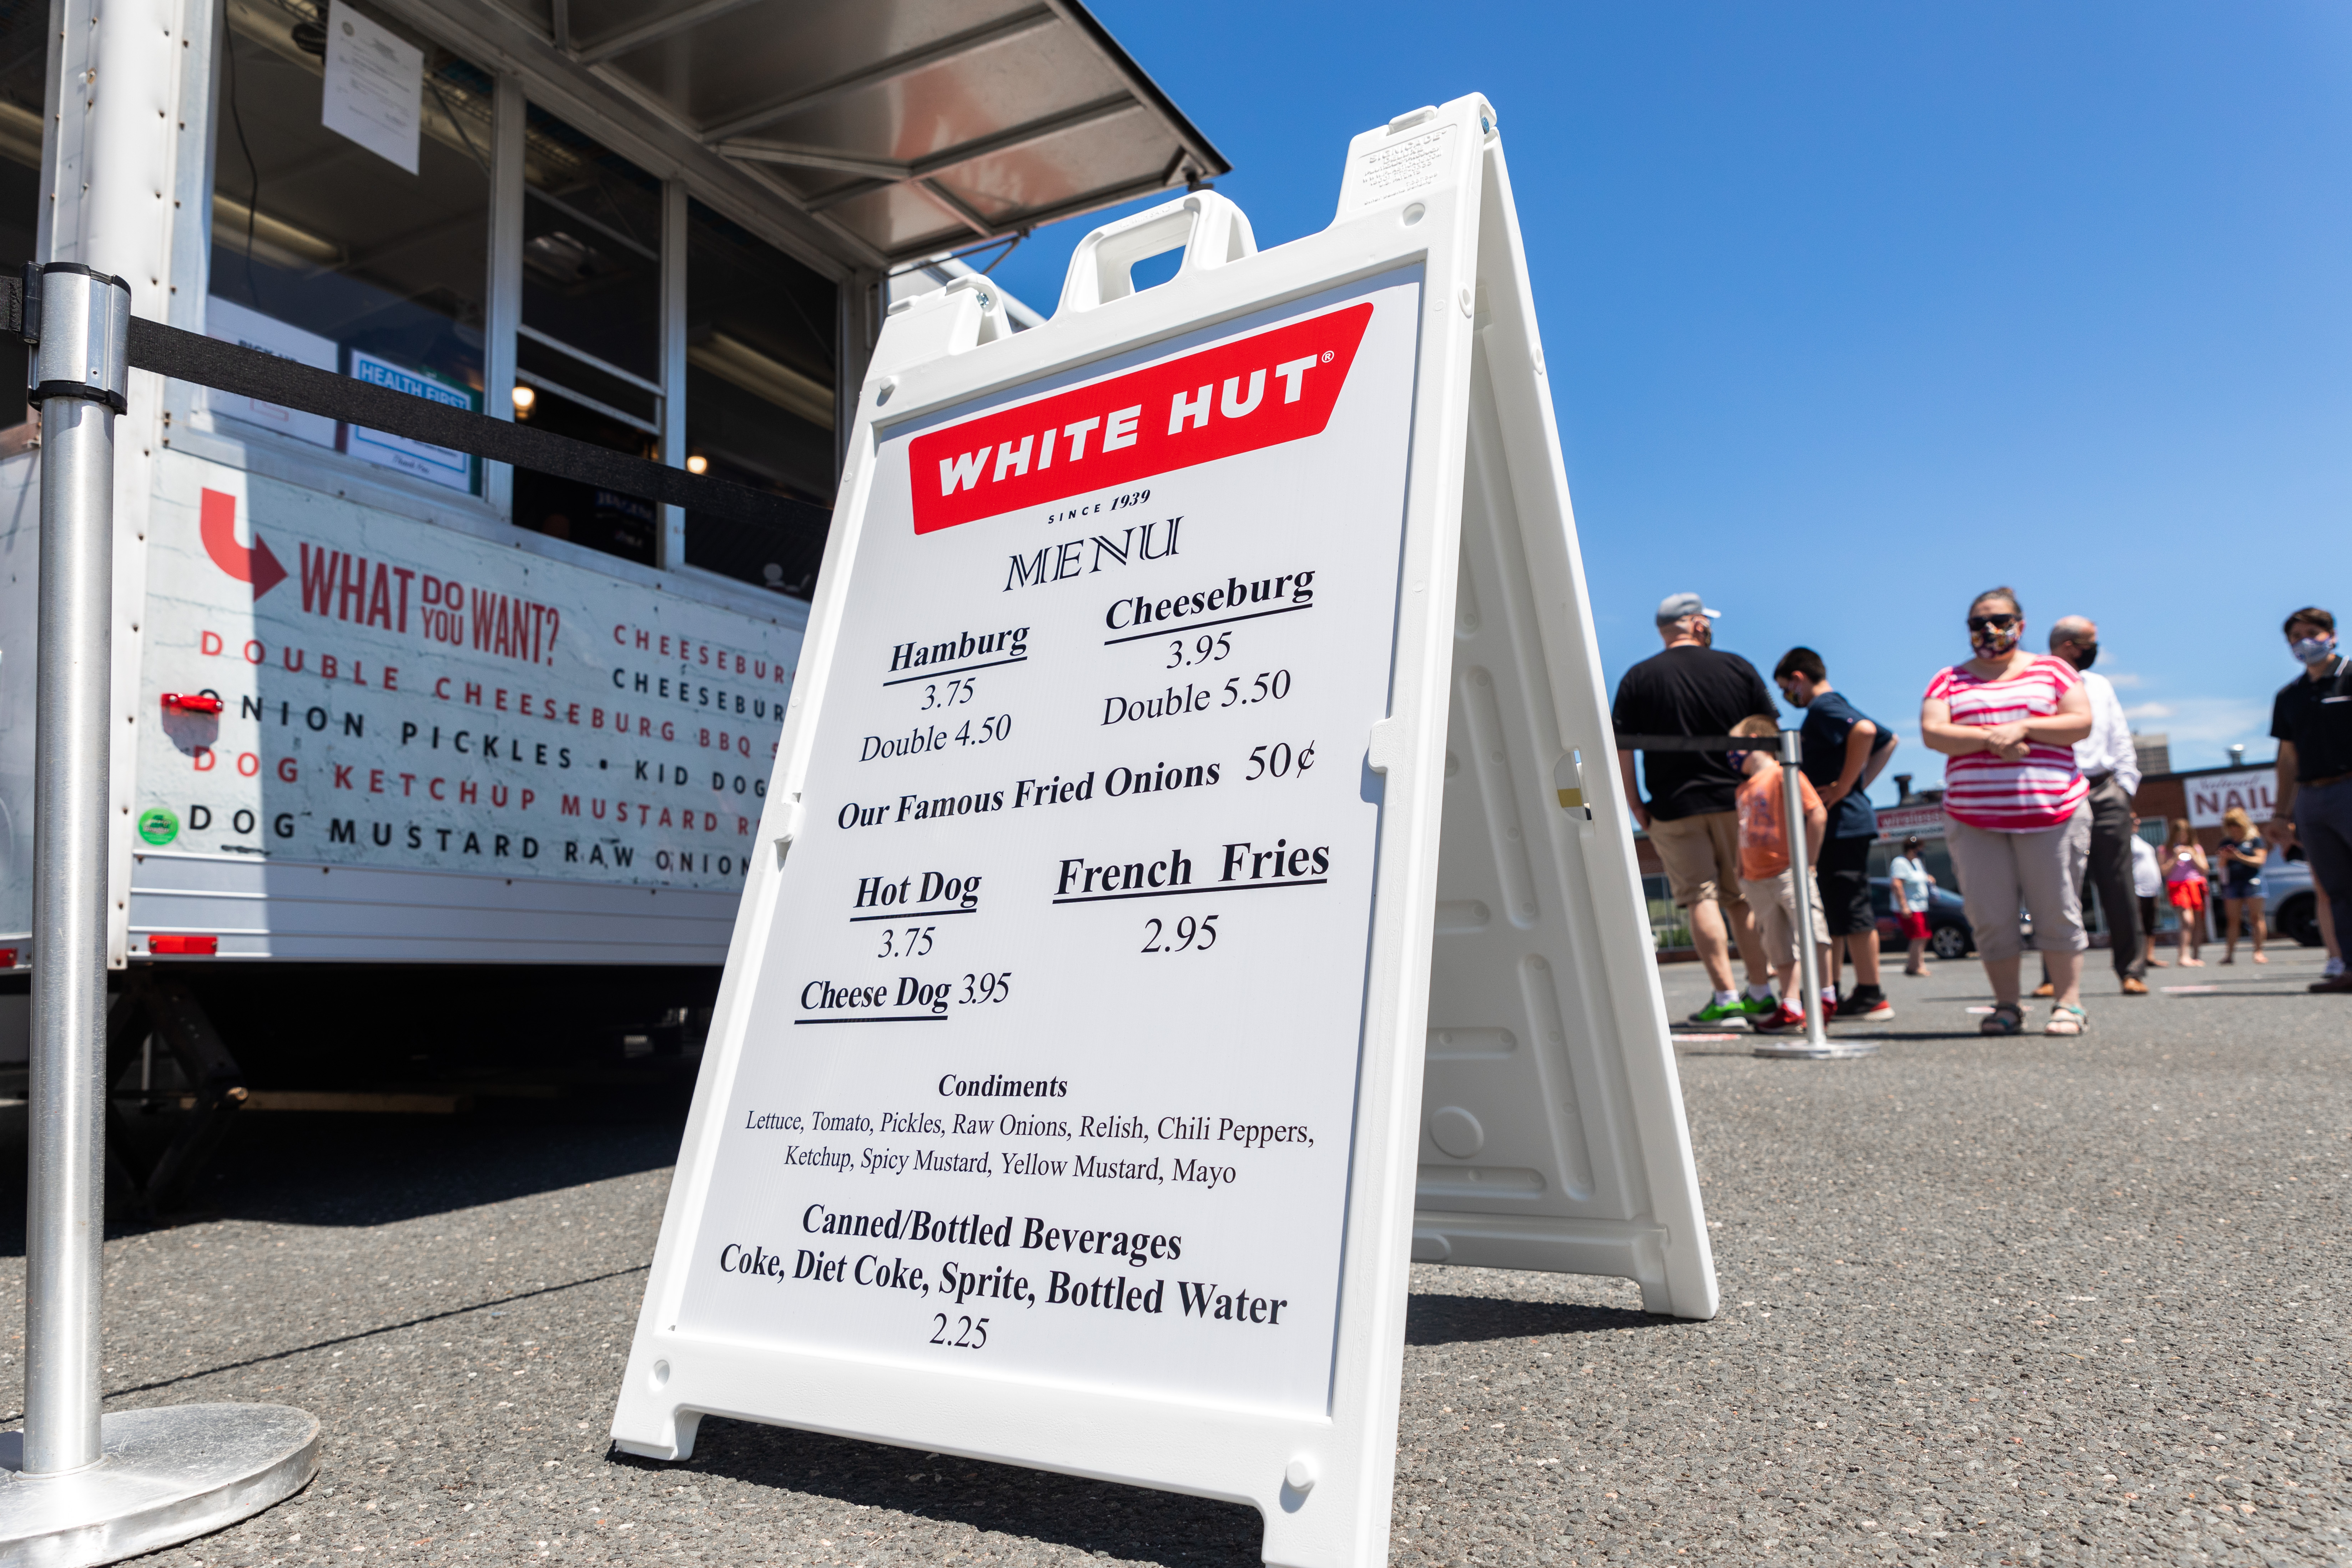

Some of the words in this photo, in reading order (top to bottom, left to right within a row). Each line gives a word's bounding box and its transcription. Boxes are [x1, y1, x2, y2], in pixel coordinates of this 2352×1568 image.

[940, 404, 1142, 496] WHITE
[1048, 504, 1100, 524] SINCE
[1110, 490, 1150, 511] 1939
[1003, 516, 1184, 592] MENU
[299, 541, 415, 634] WHAT
[422, 574, 464, 611] DO
[1106, 571, 1315, 629] Cheeseburg
[421, 605, 463, 646] YOU
[472, 588, 560, 667] WANT?
[888, 627, 1030, 672] Hamburg
[1167, 631, 1232, 669] 3.95
[613, 624, 796, 684] CHEESEBUR
[201, 630, 398, 691] DOUBLE
[434, 676, 675, 742] CHEESEBURG
[700, 728, 750, 758] BBQ
[921, 677, 976, 710] 3.75
[1101, 684, 1210, 725] Double
[1222, 670, 1290, 707] 5.50
[401, 721, 572, 769] PICKLES
[635, 759, 688, 786] KID
[713, 771, 766, 797] DOG
[859, 725, 947, 762] Double
[955, 714, 1011, 746] 4.50
[193, 745, 298, 783] DOG
[334, 764, 536, 811] KETCHUP
[562, 794, 717, 832] MUSTARD
[838, 803, 890, 829] Our
[895, 791, 1004, 822] Famous
[1012, 772, 1094, 808] Fried
[1106, 762, 1220, 796] Onions
[188, 805, 294, 838] DOG
[329, 817, 539, 861] MUSTARD
[564, 840, 634, 867] RAW
[853, 876, 911, 908] Hot
[916, 872, 982, 908] Dog
[1054, 849, 1191, 895] French
[1218, 839, 1329, 881] Fries
[878, 927, 936, 958] 3.75
[1141, 915, 1219, 953] 2.95
[801, 981, 887, 1009] Cheese
[893, 977, 952, 1013] Dog
[959, 973, 1012, 1004] 3.95
[939, 1074, 1067, 1097] Condiments
[745, 1111, 804, 1134] Lettuce,
[812, 1112, 873, 1135] Tomato,
[880, 1112, 945, 1138] Pickles,
[952, 1114, 994, 1134] Raw
[1000, 1114, 1071, 1141] Onions,
[1079, 1115, 1148, 1143] Relish,
[1158, 1117, 1210, 1139] Chili
[1217, 1118, 1313, 1148] Peppers,
[784, 1146, 853, 1172] Ketchup,
[861, 1148, 910, 1175] Spicy
[913, 1150, 991, 1178] Mustard,
[1002, 1153, 1068, 1176] Yellow
[1073, 1155, 1163, 1185] Mustard,
[1172, 1159, 1235, 1189] Mayo
[803, 1204, 1013, 1247] Canned/Bottled
[1020, 1217, 1181, 1267] Beverages
[721, 1244, 784, 1284] Coke,
[792, 1250, 847, 1282] Diet
[855, 1255, 928, 1298] Coke,
[939, 1262, 1035, 1309] Sprite,
[1045, 1271, 1164, 1313] Bottled
[1177, 1281, 1287, 1324] Water
[930, 1313, 989, 1348] 2.25
